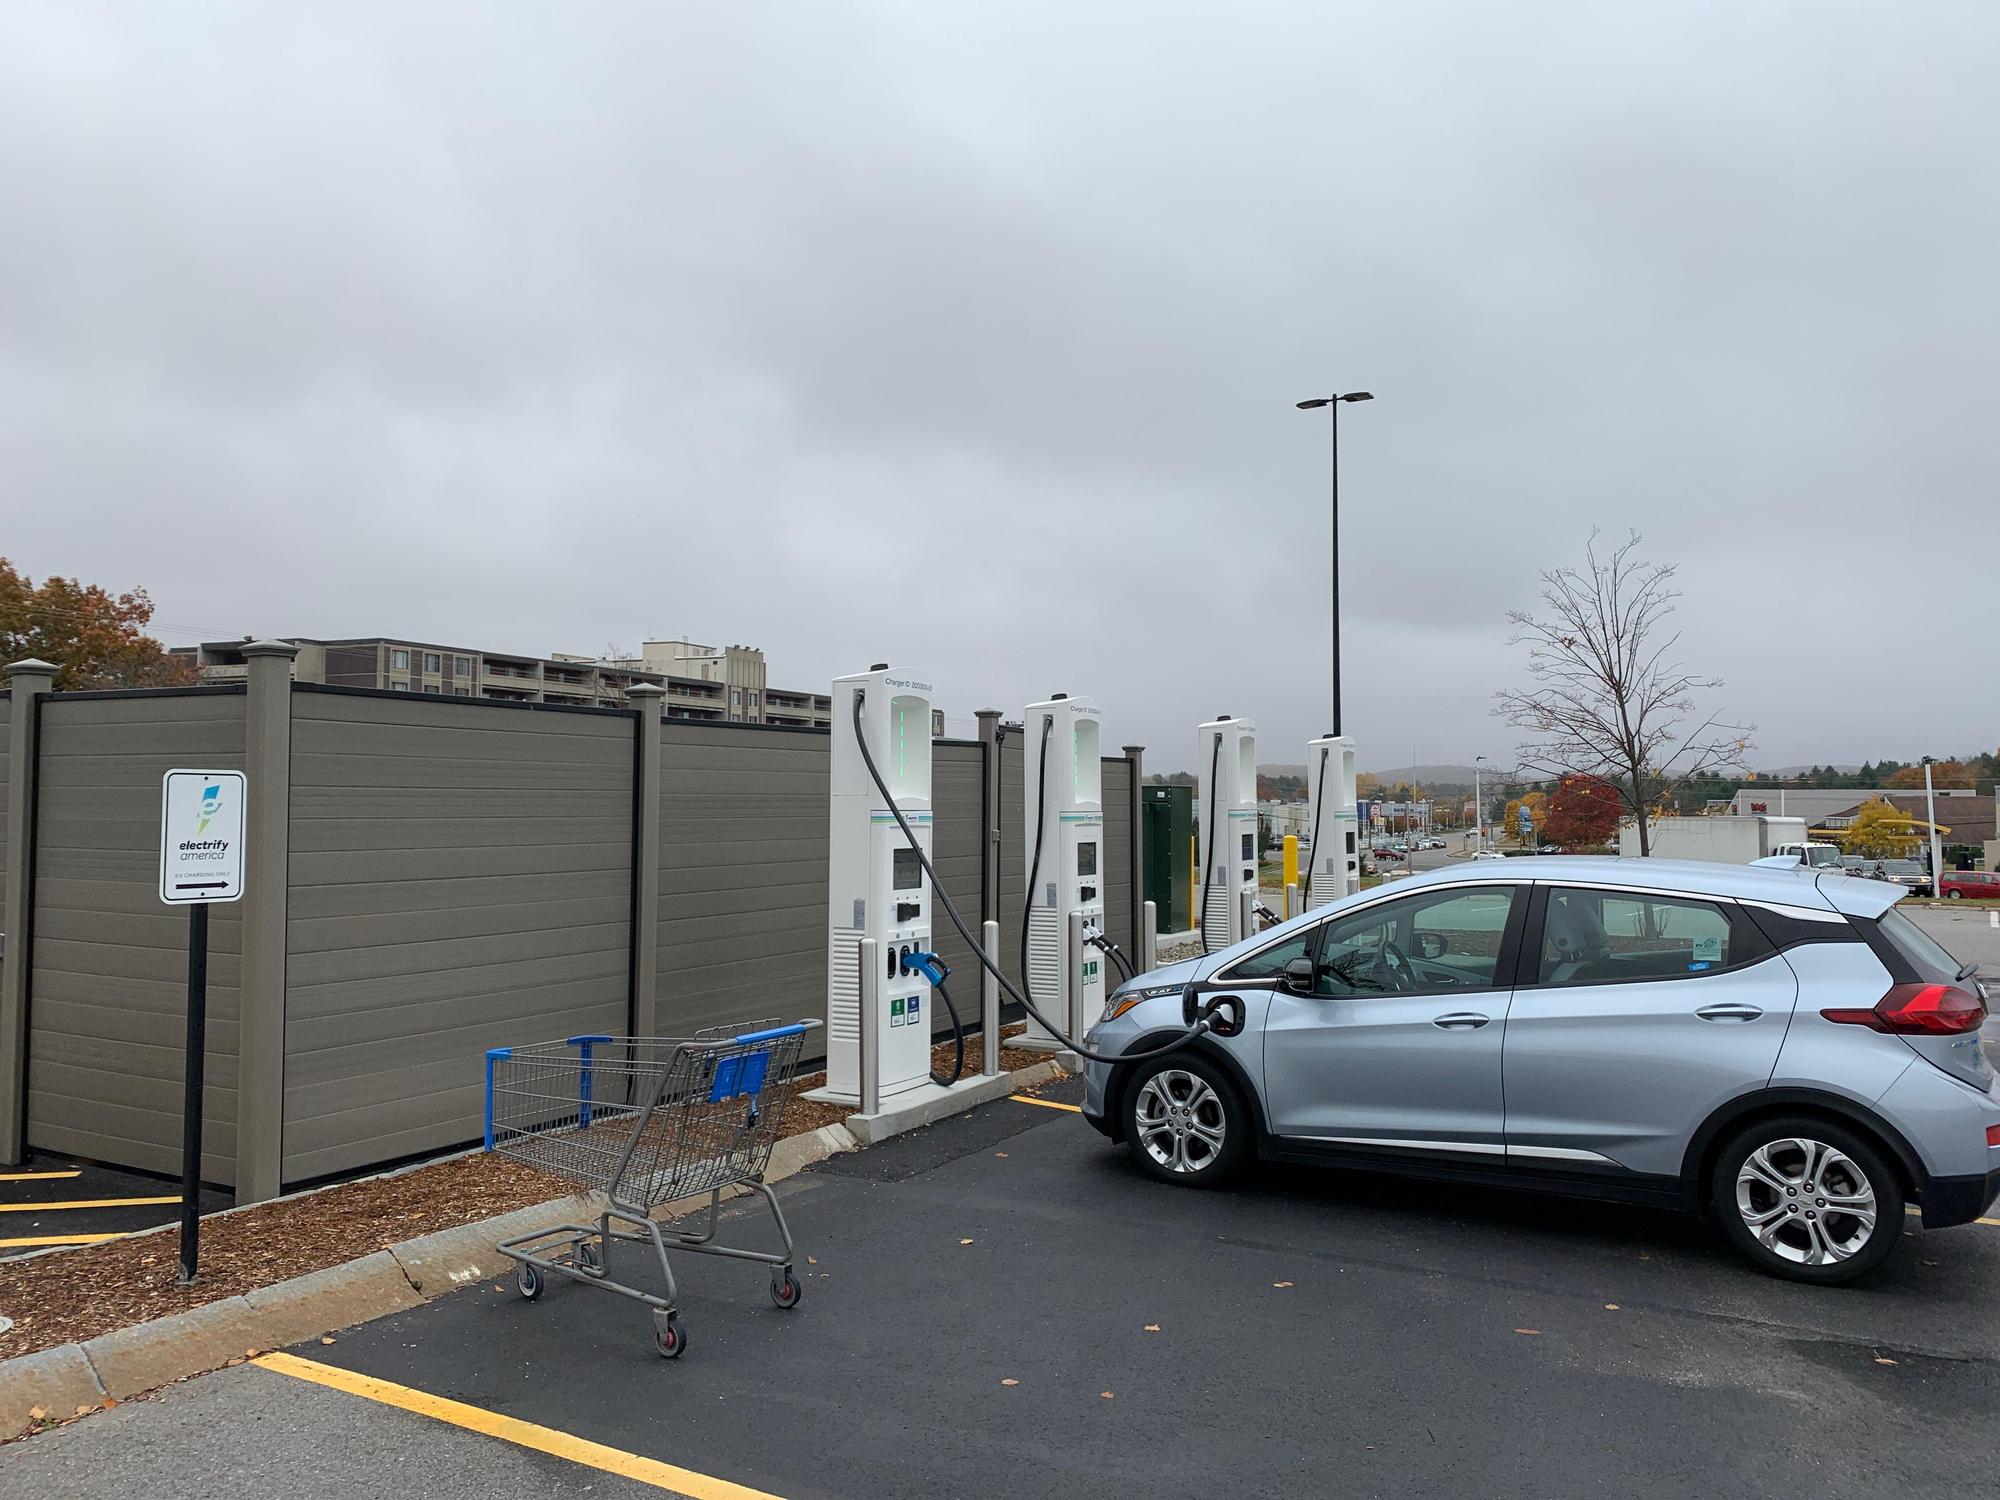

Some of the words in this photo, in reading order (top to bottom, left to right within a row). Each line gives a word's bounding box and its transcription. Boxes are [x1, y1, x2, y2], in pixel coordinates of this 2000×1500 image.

[885, 678, 905, 688] Charger
[179, 840, 228, 851] electrify
[180, 850, 225, 860] america
